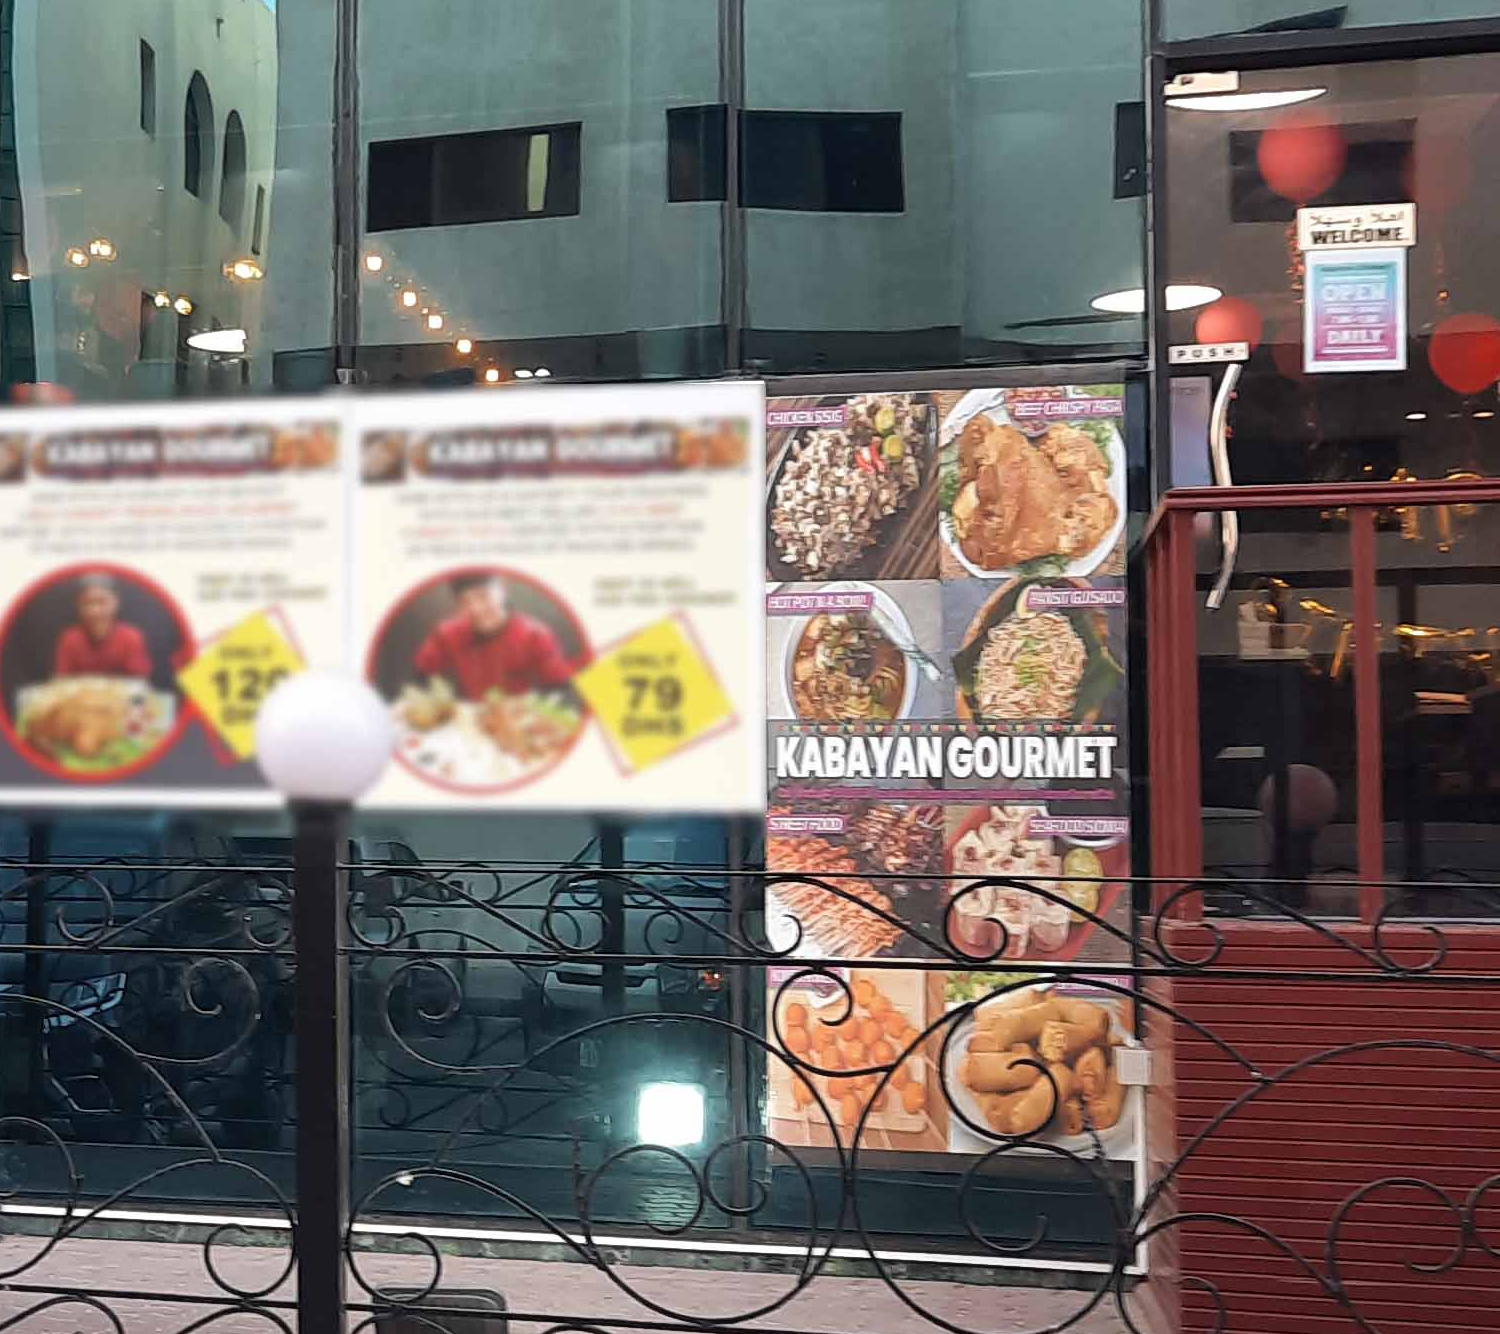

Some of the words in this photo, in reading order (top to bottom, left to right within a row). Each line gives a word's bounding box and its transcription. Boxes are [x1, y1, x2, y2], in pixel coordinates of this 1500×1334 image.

[1310, 226, 1405, 246] WELCOME
[1176, 347, 1236, 359] PUSH
[622, 675, 684, 712] 79
[775, 736, 943, 779] KABAYAN
[947, 736, 1117, 779] GOURMET
